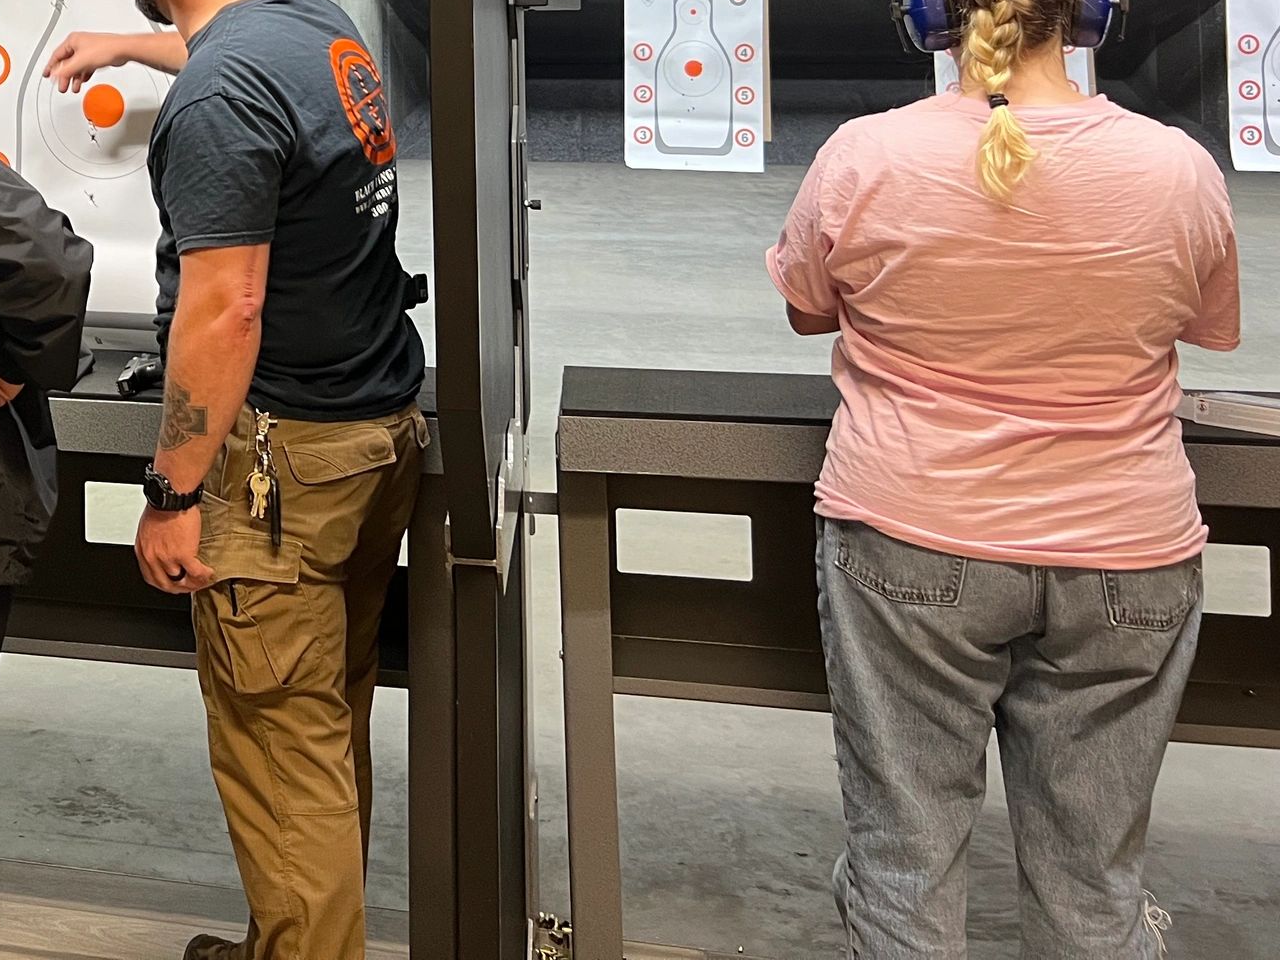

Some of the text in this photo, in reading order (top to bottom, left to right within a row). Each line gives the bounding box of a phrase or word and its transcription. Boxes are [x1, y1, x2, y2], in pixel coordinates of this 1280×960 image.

[1245, 39, 1252, 50] 1
[640, 48, 646, 57] 1
[740, 48, 748, 57] 4
[640, 89, 647, 99] 2
[741, 90, 749, 100] 5
[1245, 85, 1254, 95] 2
[639, 130, 647, 140] 3
[741, 133, 749, 142] 6
[1246, 130, 1255, 141] 3
